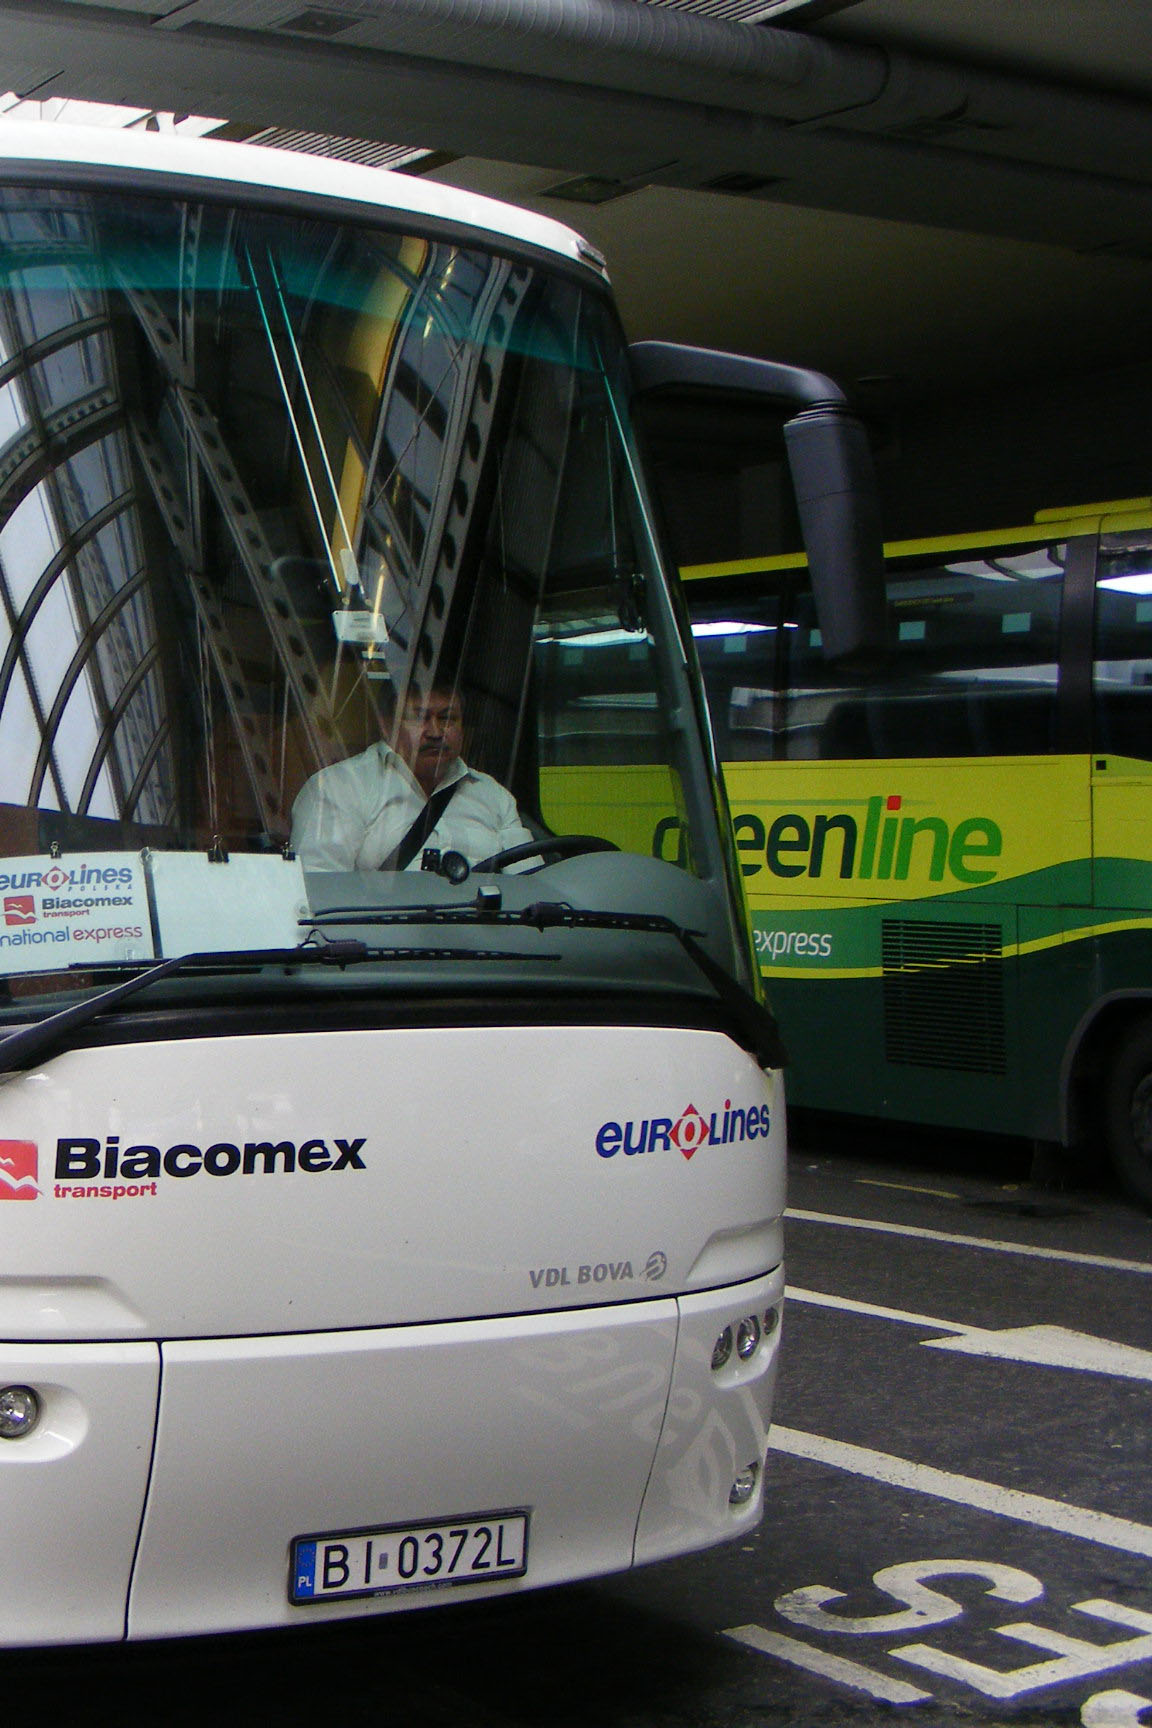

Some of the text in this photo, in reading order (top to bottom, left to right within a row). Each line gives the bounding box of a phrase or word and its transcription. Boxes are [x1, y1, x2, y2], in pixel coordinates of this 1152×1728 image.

[67, 884, 133, 892] POLSKA
[42, 896, 134, 910] Biacomex
[43, 909, 90, 919] transport
[0, 926, 143, 947] national express
[54, 1136, 367, 1180] Biacomex
[54, 1181, 158, 1200] transport
[529, 1261, 634, 1288] VDL BOVA
[297, 1524, 516, 1589] PL BI 0372L
